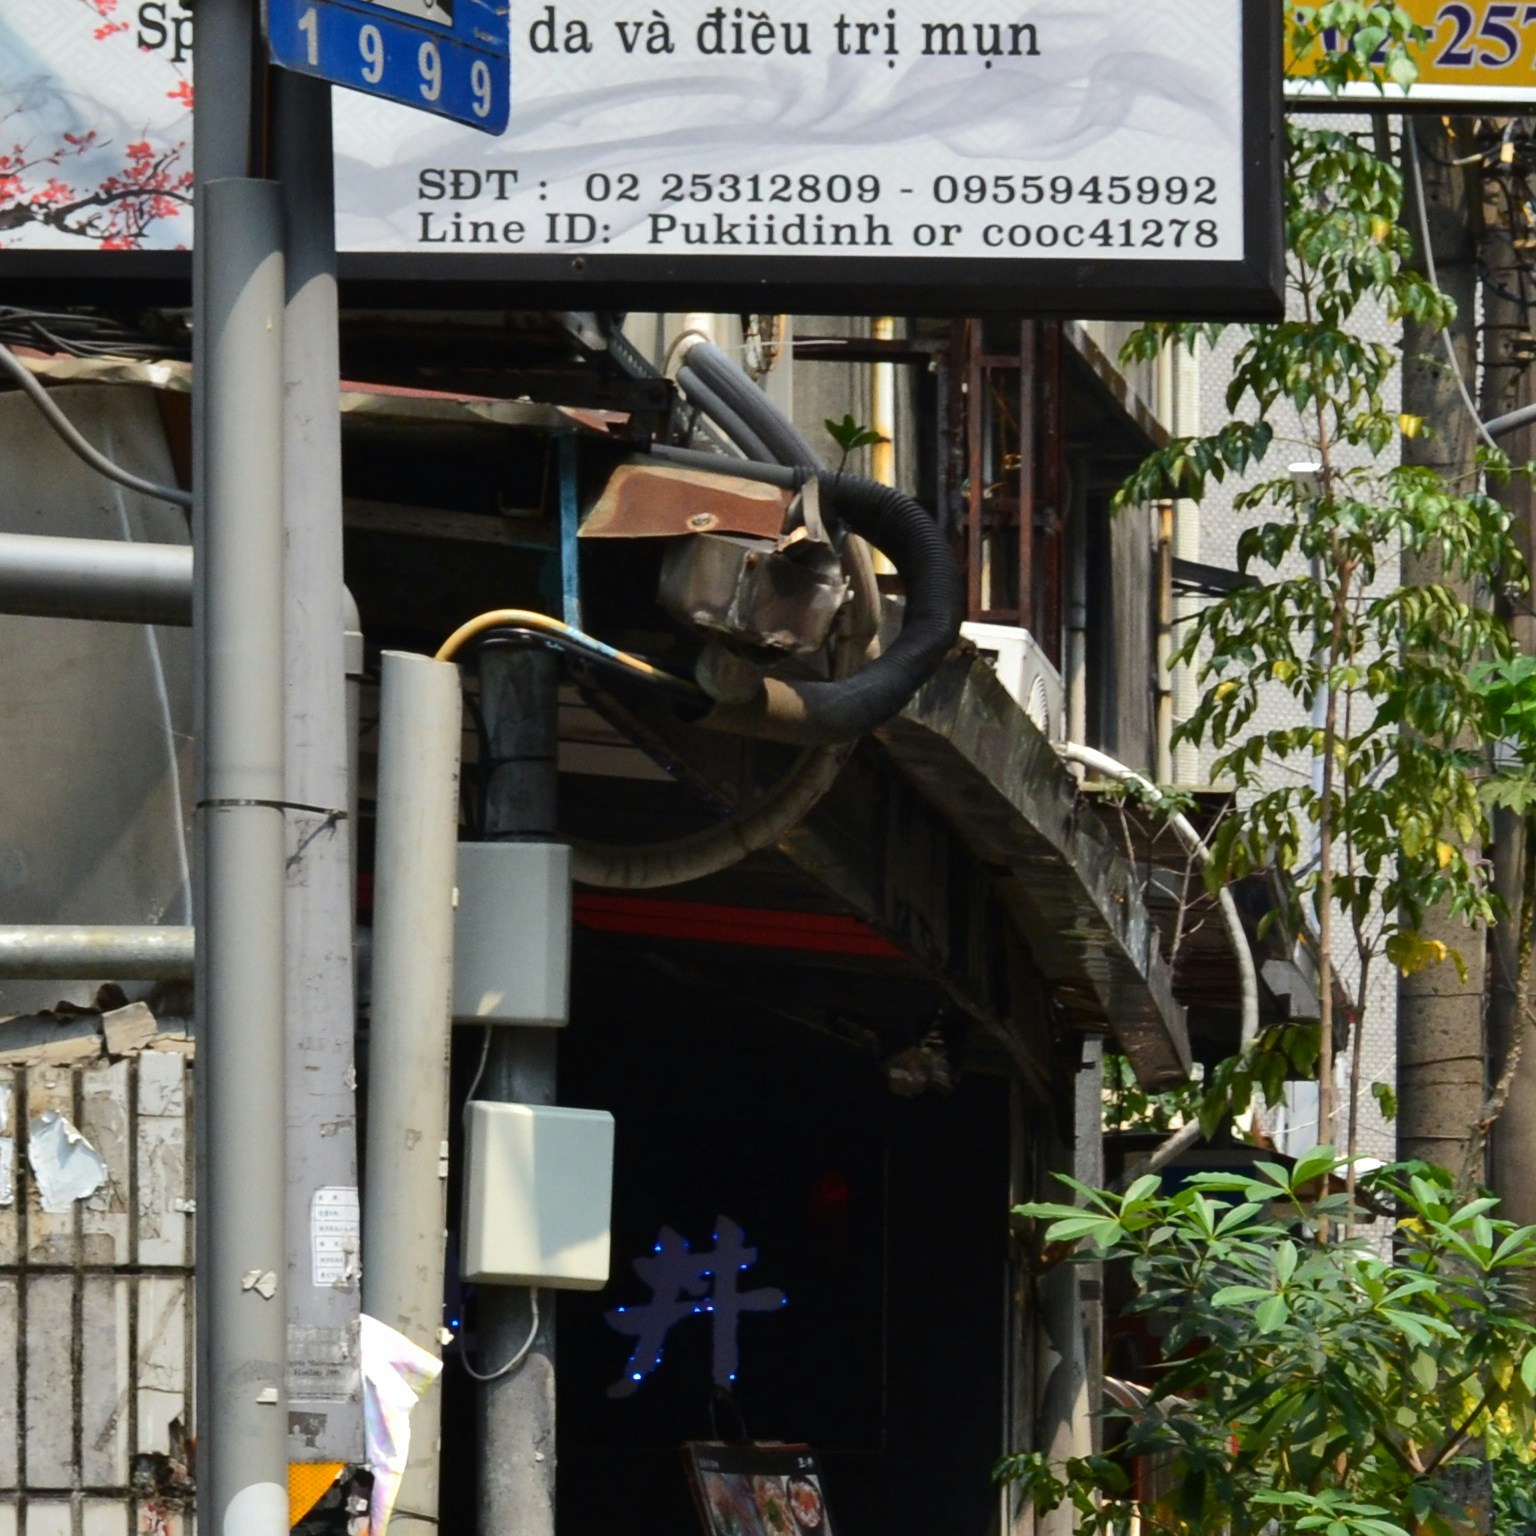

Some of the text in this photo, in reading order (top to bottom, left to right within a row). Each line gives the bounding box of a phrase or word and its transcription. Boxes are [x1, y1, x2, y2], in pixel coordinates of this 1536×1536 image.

[529, 5, 594, 53] da
[615, 9, 675, 53] và
[696, 7, 812, 54] điều
[834, 8, 900, 69] trị
[921, 20, 1041, 69] mụn
[297, 8, 492, 118] 1999
[418, 169, 519, 201] SĐT
[586, 173, 640, 202] 02
[660, 174, 880, 203] 25312809
[932, 174, 1218, 205] 0955945992
[418, 212, 1219, 248] Line ID: Pukiidinh or cooc41278
